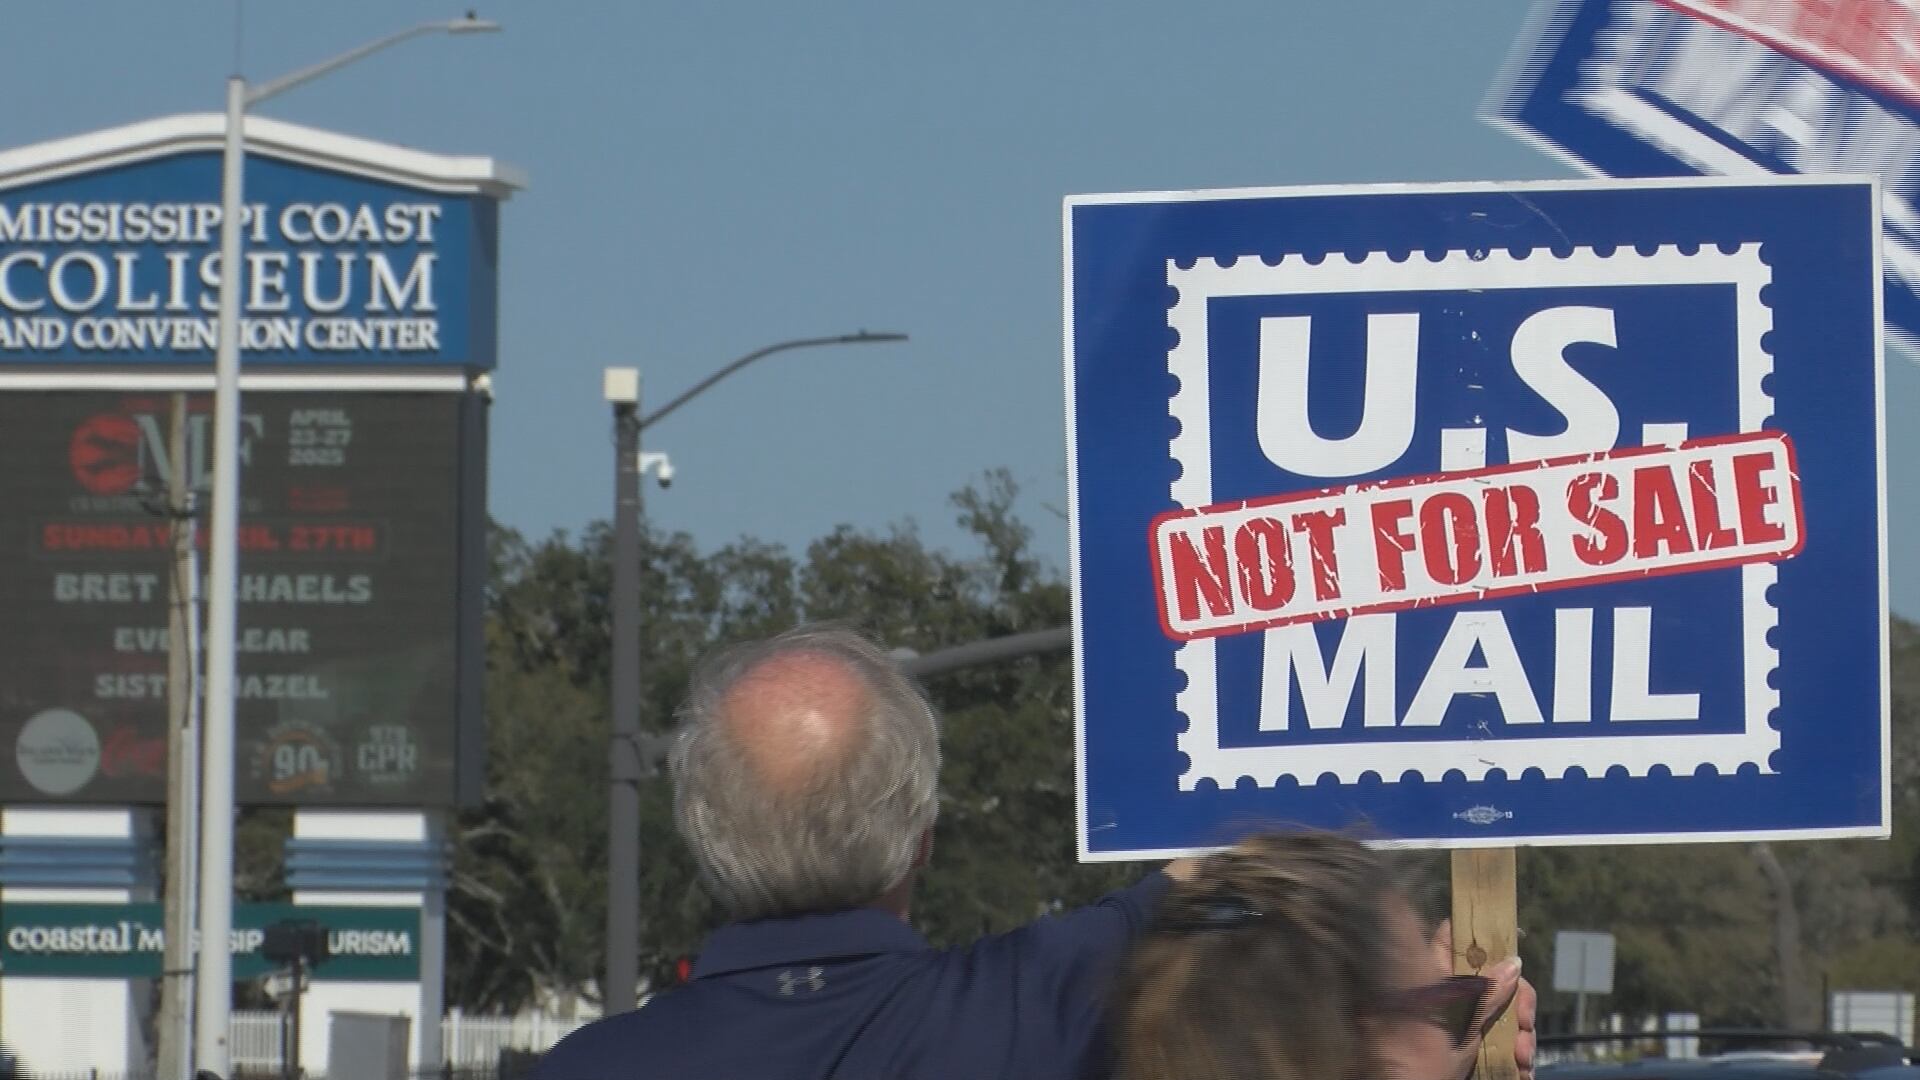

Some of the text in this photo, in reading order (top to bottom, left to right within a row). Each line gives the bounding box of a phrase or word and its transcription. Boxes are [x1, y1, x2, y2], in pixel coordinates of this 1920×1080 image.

[280, 203, 441, 242] COAST
[72, 317, 300, 349] CONVENION
[305, 318, 439, 349] CENTER
[1256, 304, 1688, 478] U.S.
[289, 409, 351, 425] APRIL
[43, 524, 172, 550] SUNDAY
[288, 525, 375, 551] 27TH
[1169, 451, 1786, 622] NOT FOR SALE
[54, 574, 158, 601] BRET
[1258, 606, 1701, 732] MAIL
[8, 920, 131, 952] coastal
[327, 930, 411, 955] URISM
